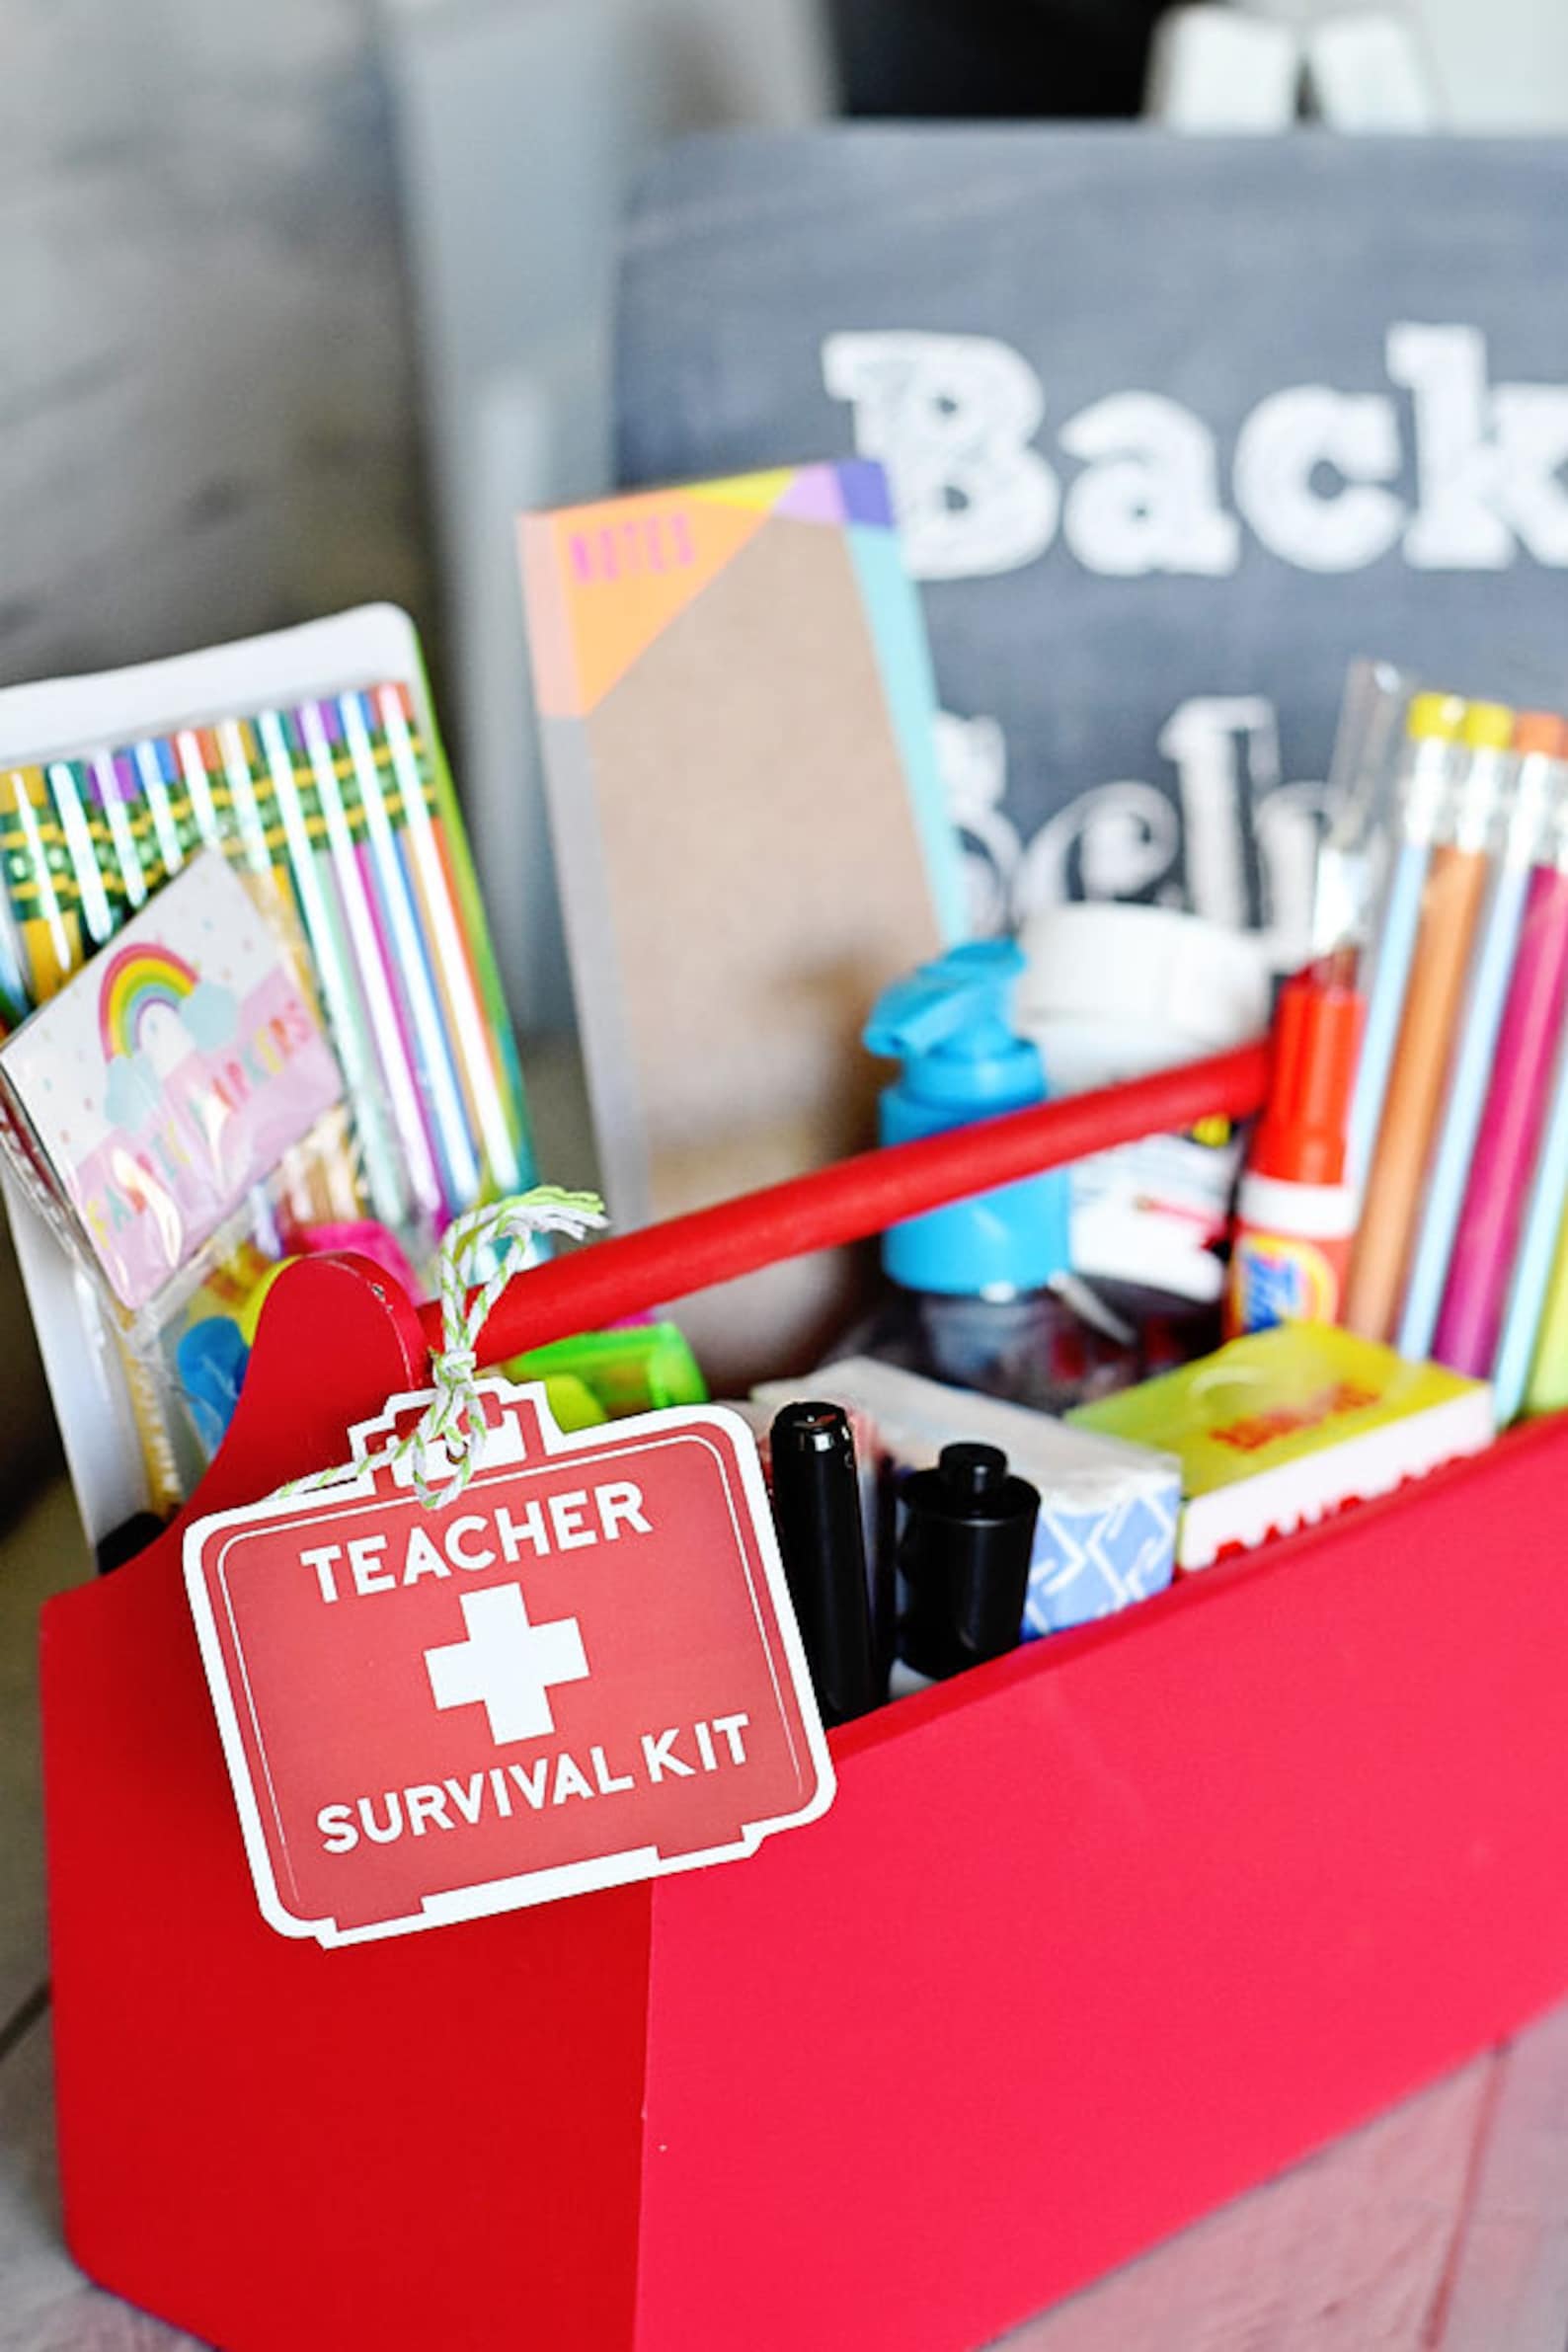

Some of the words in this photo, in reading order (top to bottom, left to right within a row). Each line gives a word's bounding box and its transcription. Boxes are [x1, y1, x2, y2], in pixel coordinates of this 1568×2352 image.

[822, 322, 1568, 581] Back
[299, 1481, 654, 1604] TEACHER
[316, 1746, 635, 1854] SURVIVAL
[640, 1712, 750, 1783] KIT
